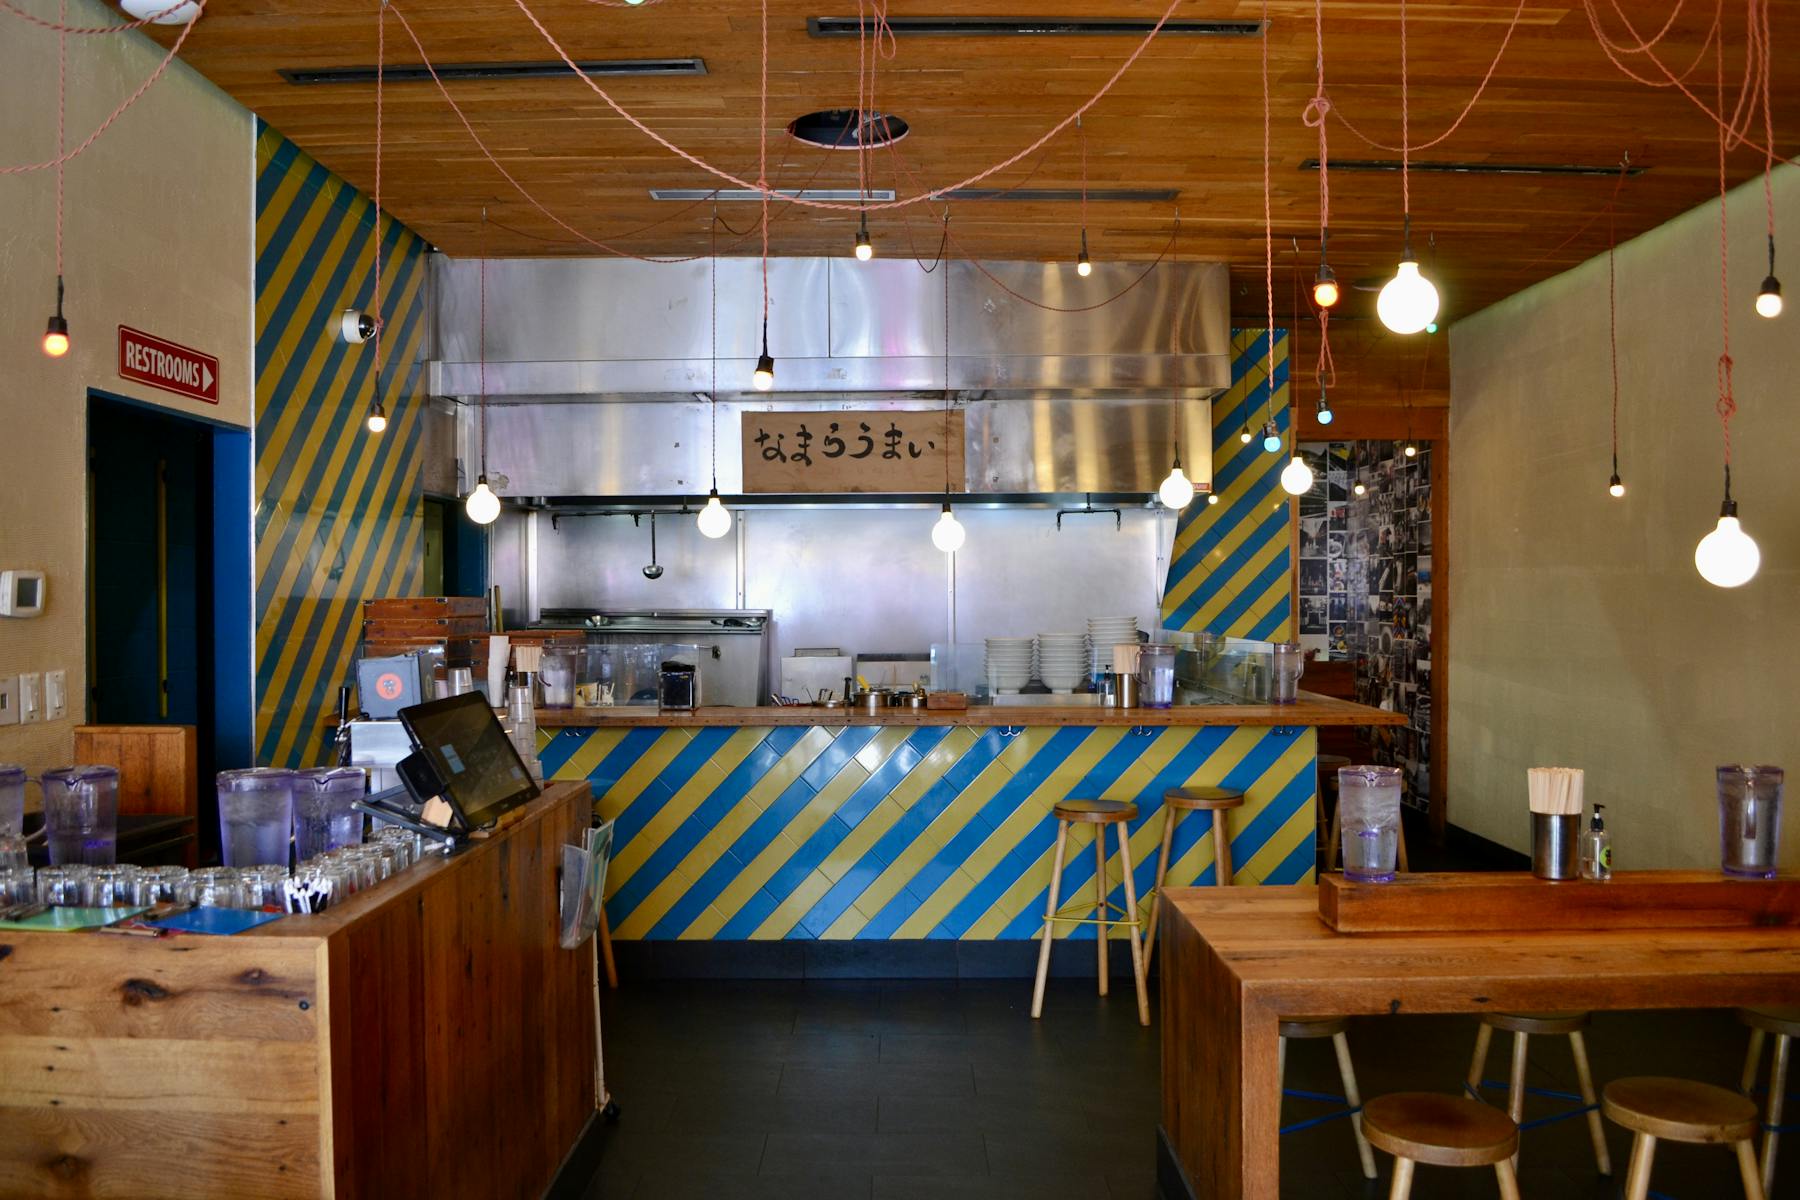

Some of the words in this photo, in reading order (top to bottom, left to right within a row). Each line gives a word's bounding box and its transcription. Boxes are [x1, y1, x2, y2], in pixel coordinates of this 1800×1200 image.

[126, 340, 200, 387] RESTROOMS
[754, 422, 935, 466] なまらうまい
